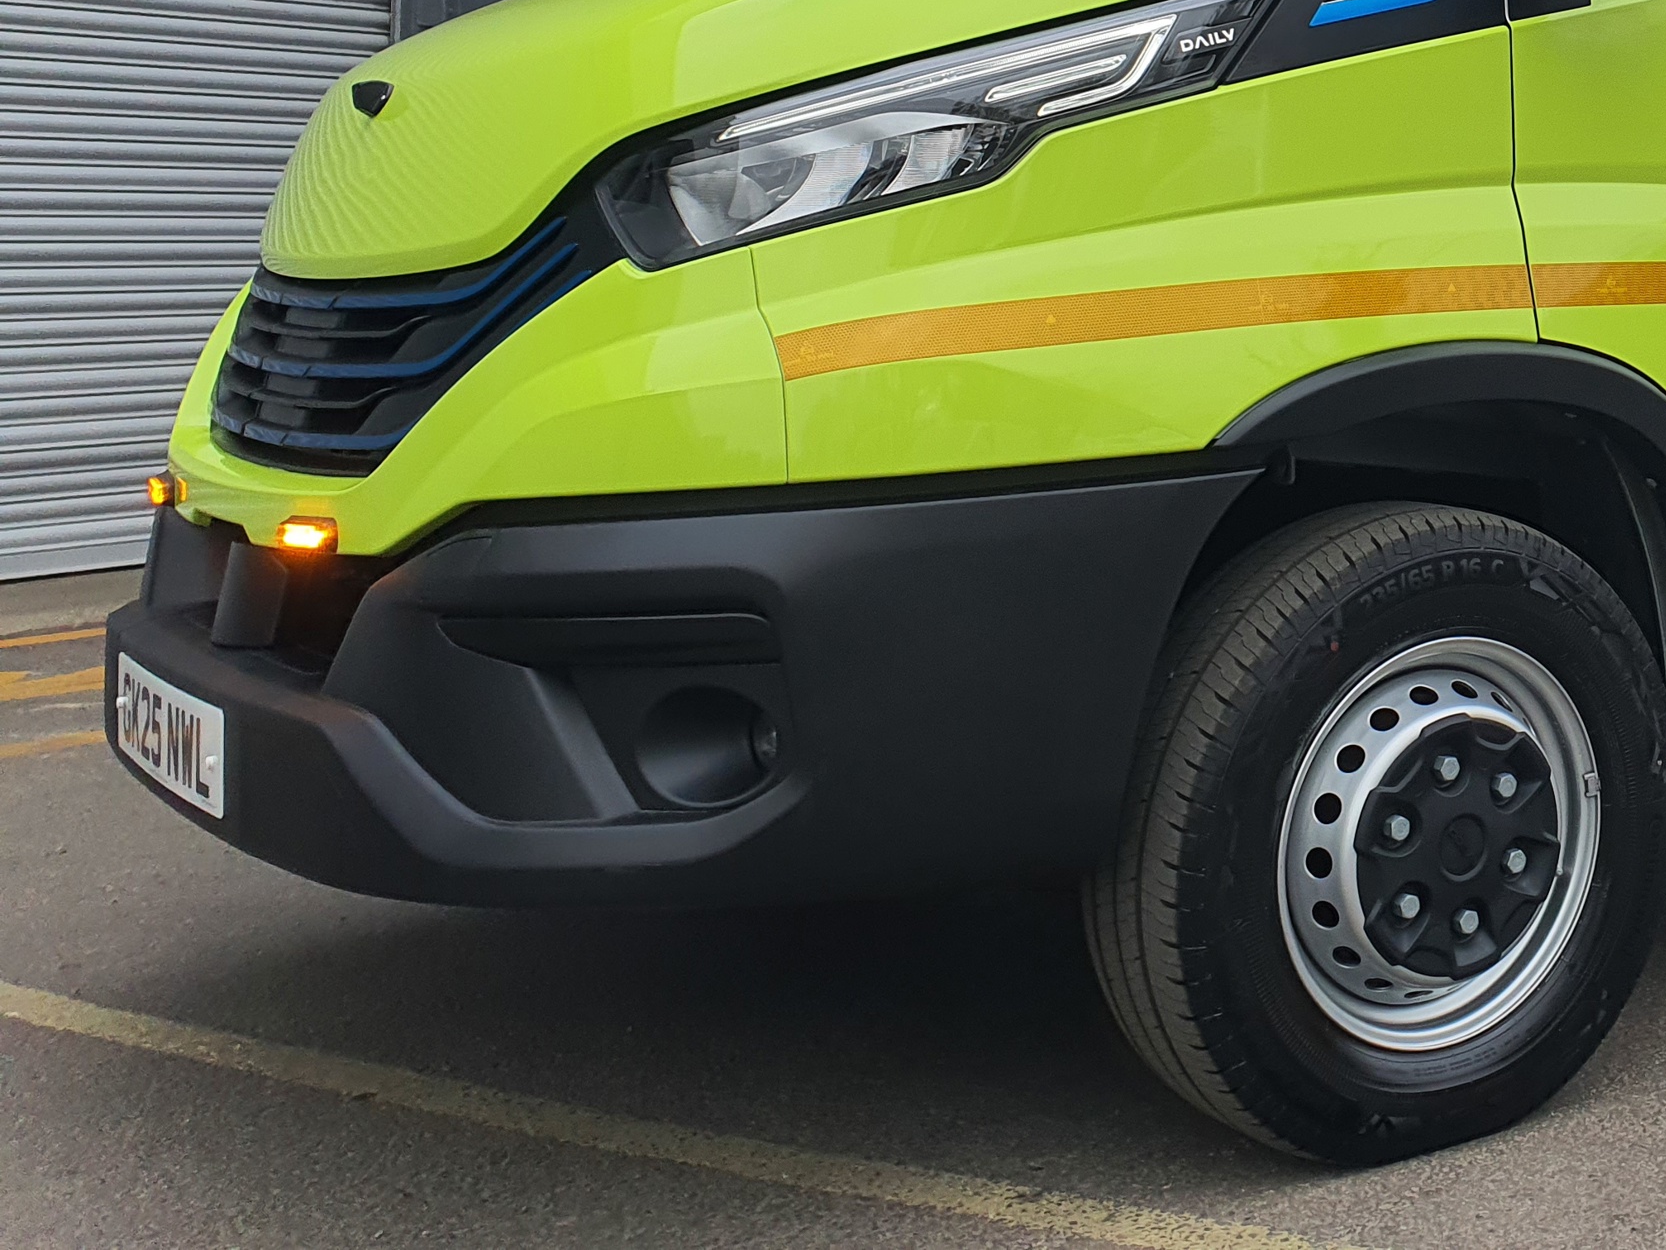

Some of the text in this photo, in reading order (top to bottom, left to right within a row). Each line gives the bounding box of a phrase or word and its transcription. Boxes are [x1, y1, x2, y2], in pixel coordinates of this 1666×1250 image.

[1180, 28, 1235, 53] DAILY
[1460, 558, 1482, 579] 16
[166, 702, 210, 799] NWL
